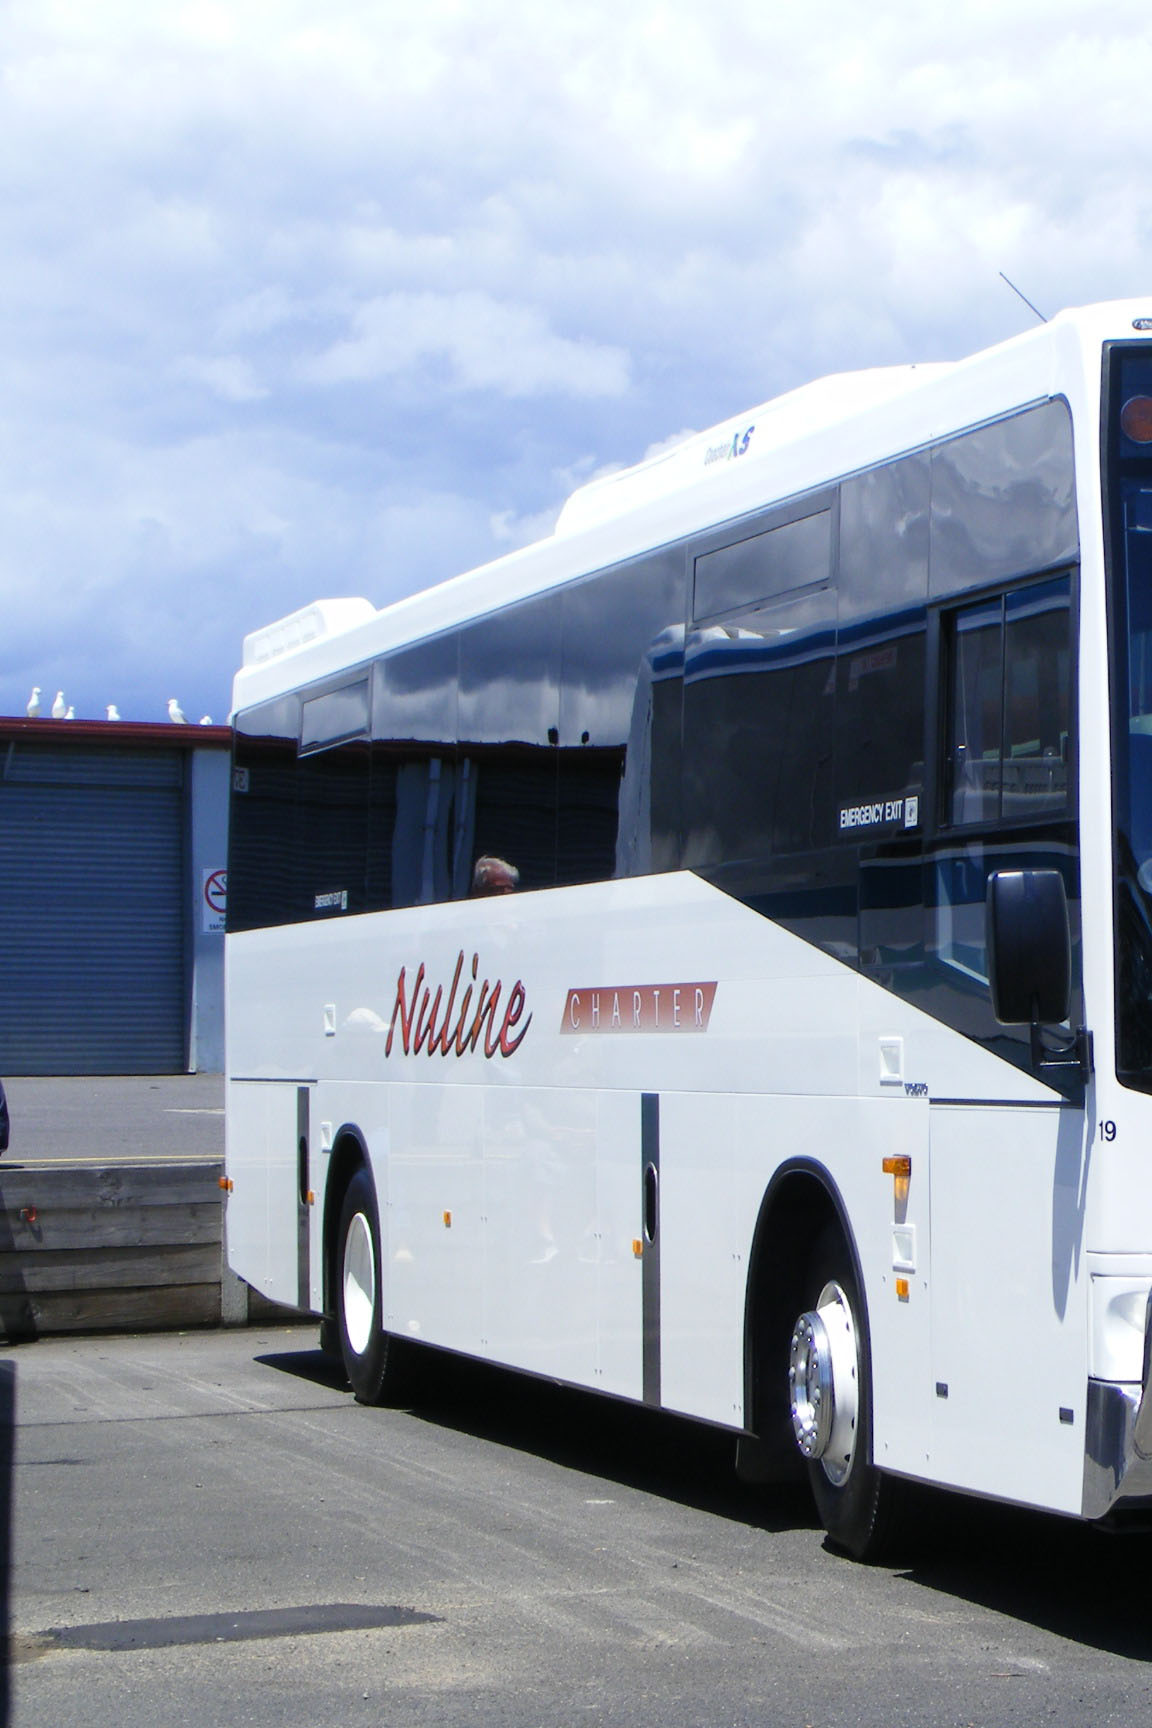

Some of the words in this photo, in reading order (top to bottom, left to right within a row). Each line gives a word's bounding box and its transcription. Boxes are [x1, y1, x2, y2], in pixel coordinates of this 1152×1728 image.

[840, 803, 884, 829] EMERGENCY
[885, 799, 904, 822] EXIT
[384, 949, 533, 1060] Nuline
[569, 987, 705, 1031] CHARTER
[1098, 1119, 1117, 1142] 19
